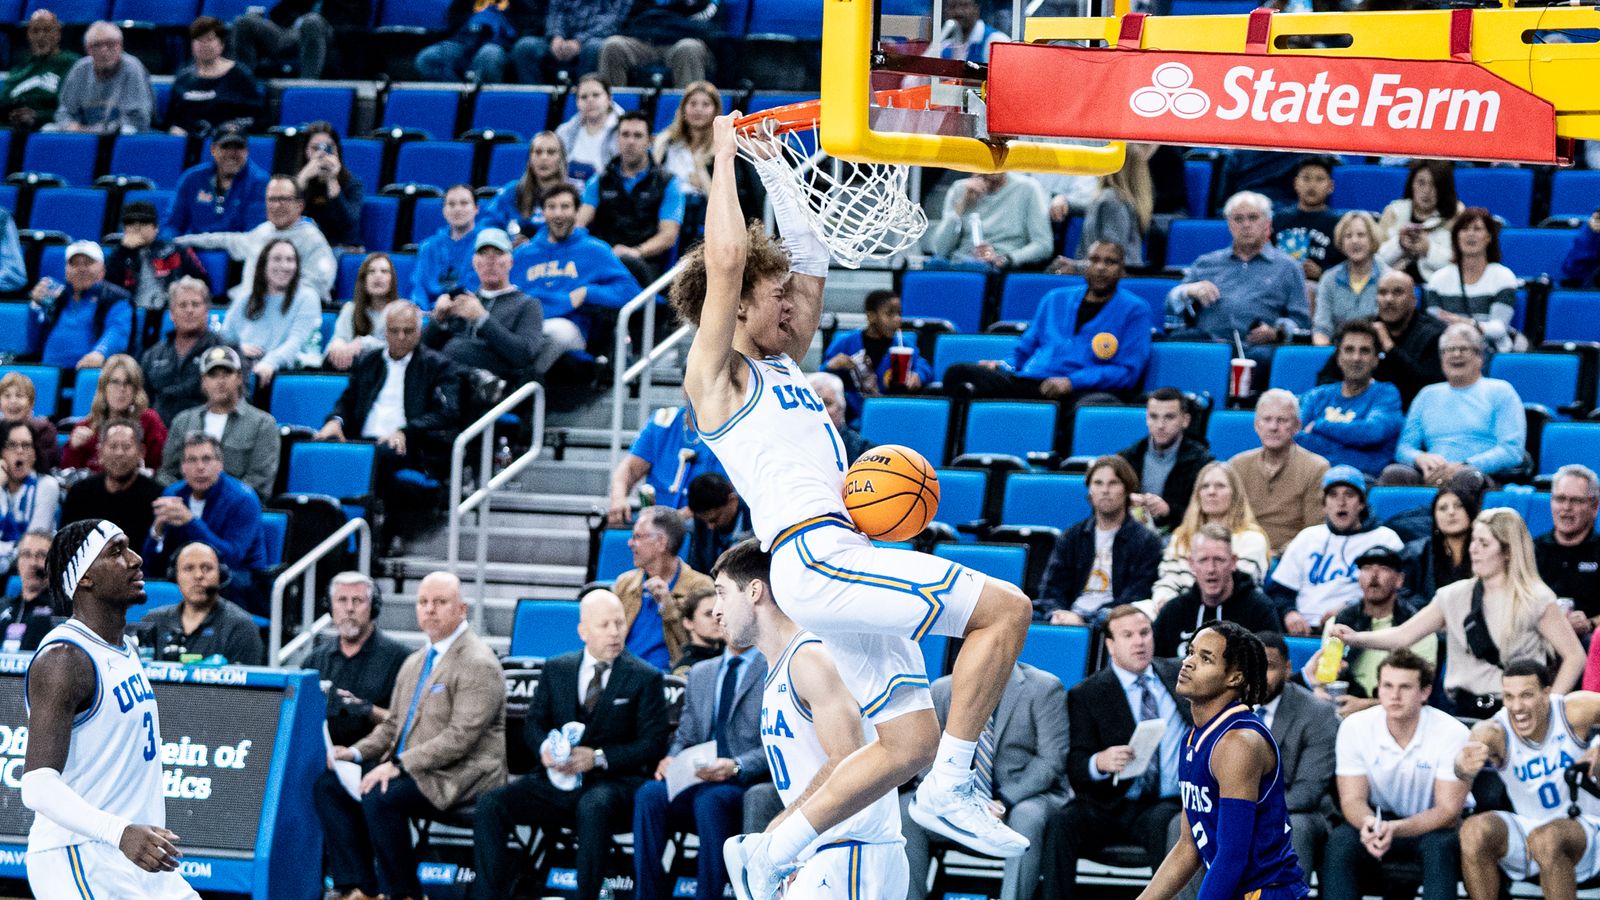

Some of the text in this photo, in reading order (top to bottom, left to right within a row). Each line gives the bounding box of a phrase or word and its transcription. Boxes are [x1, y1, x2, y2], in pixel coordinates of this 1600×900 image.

[772, 385, 824, 412] UCL
[823, 422, 844, 472] 1
[113, 673, 155, 713] UCL
[143, 711, 157, 762] 3
[761, 707, 795, 739] LA
[214, 739, 252, 769] of
[1538, 782, 1561, 809] 0
[179, 861, 212, 878] COM
